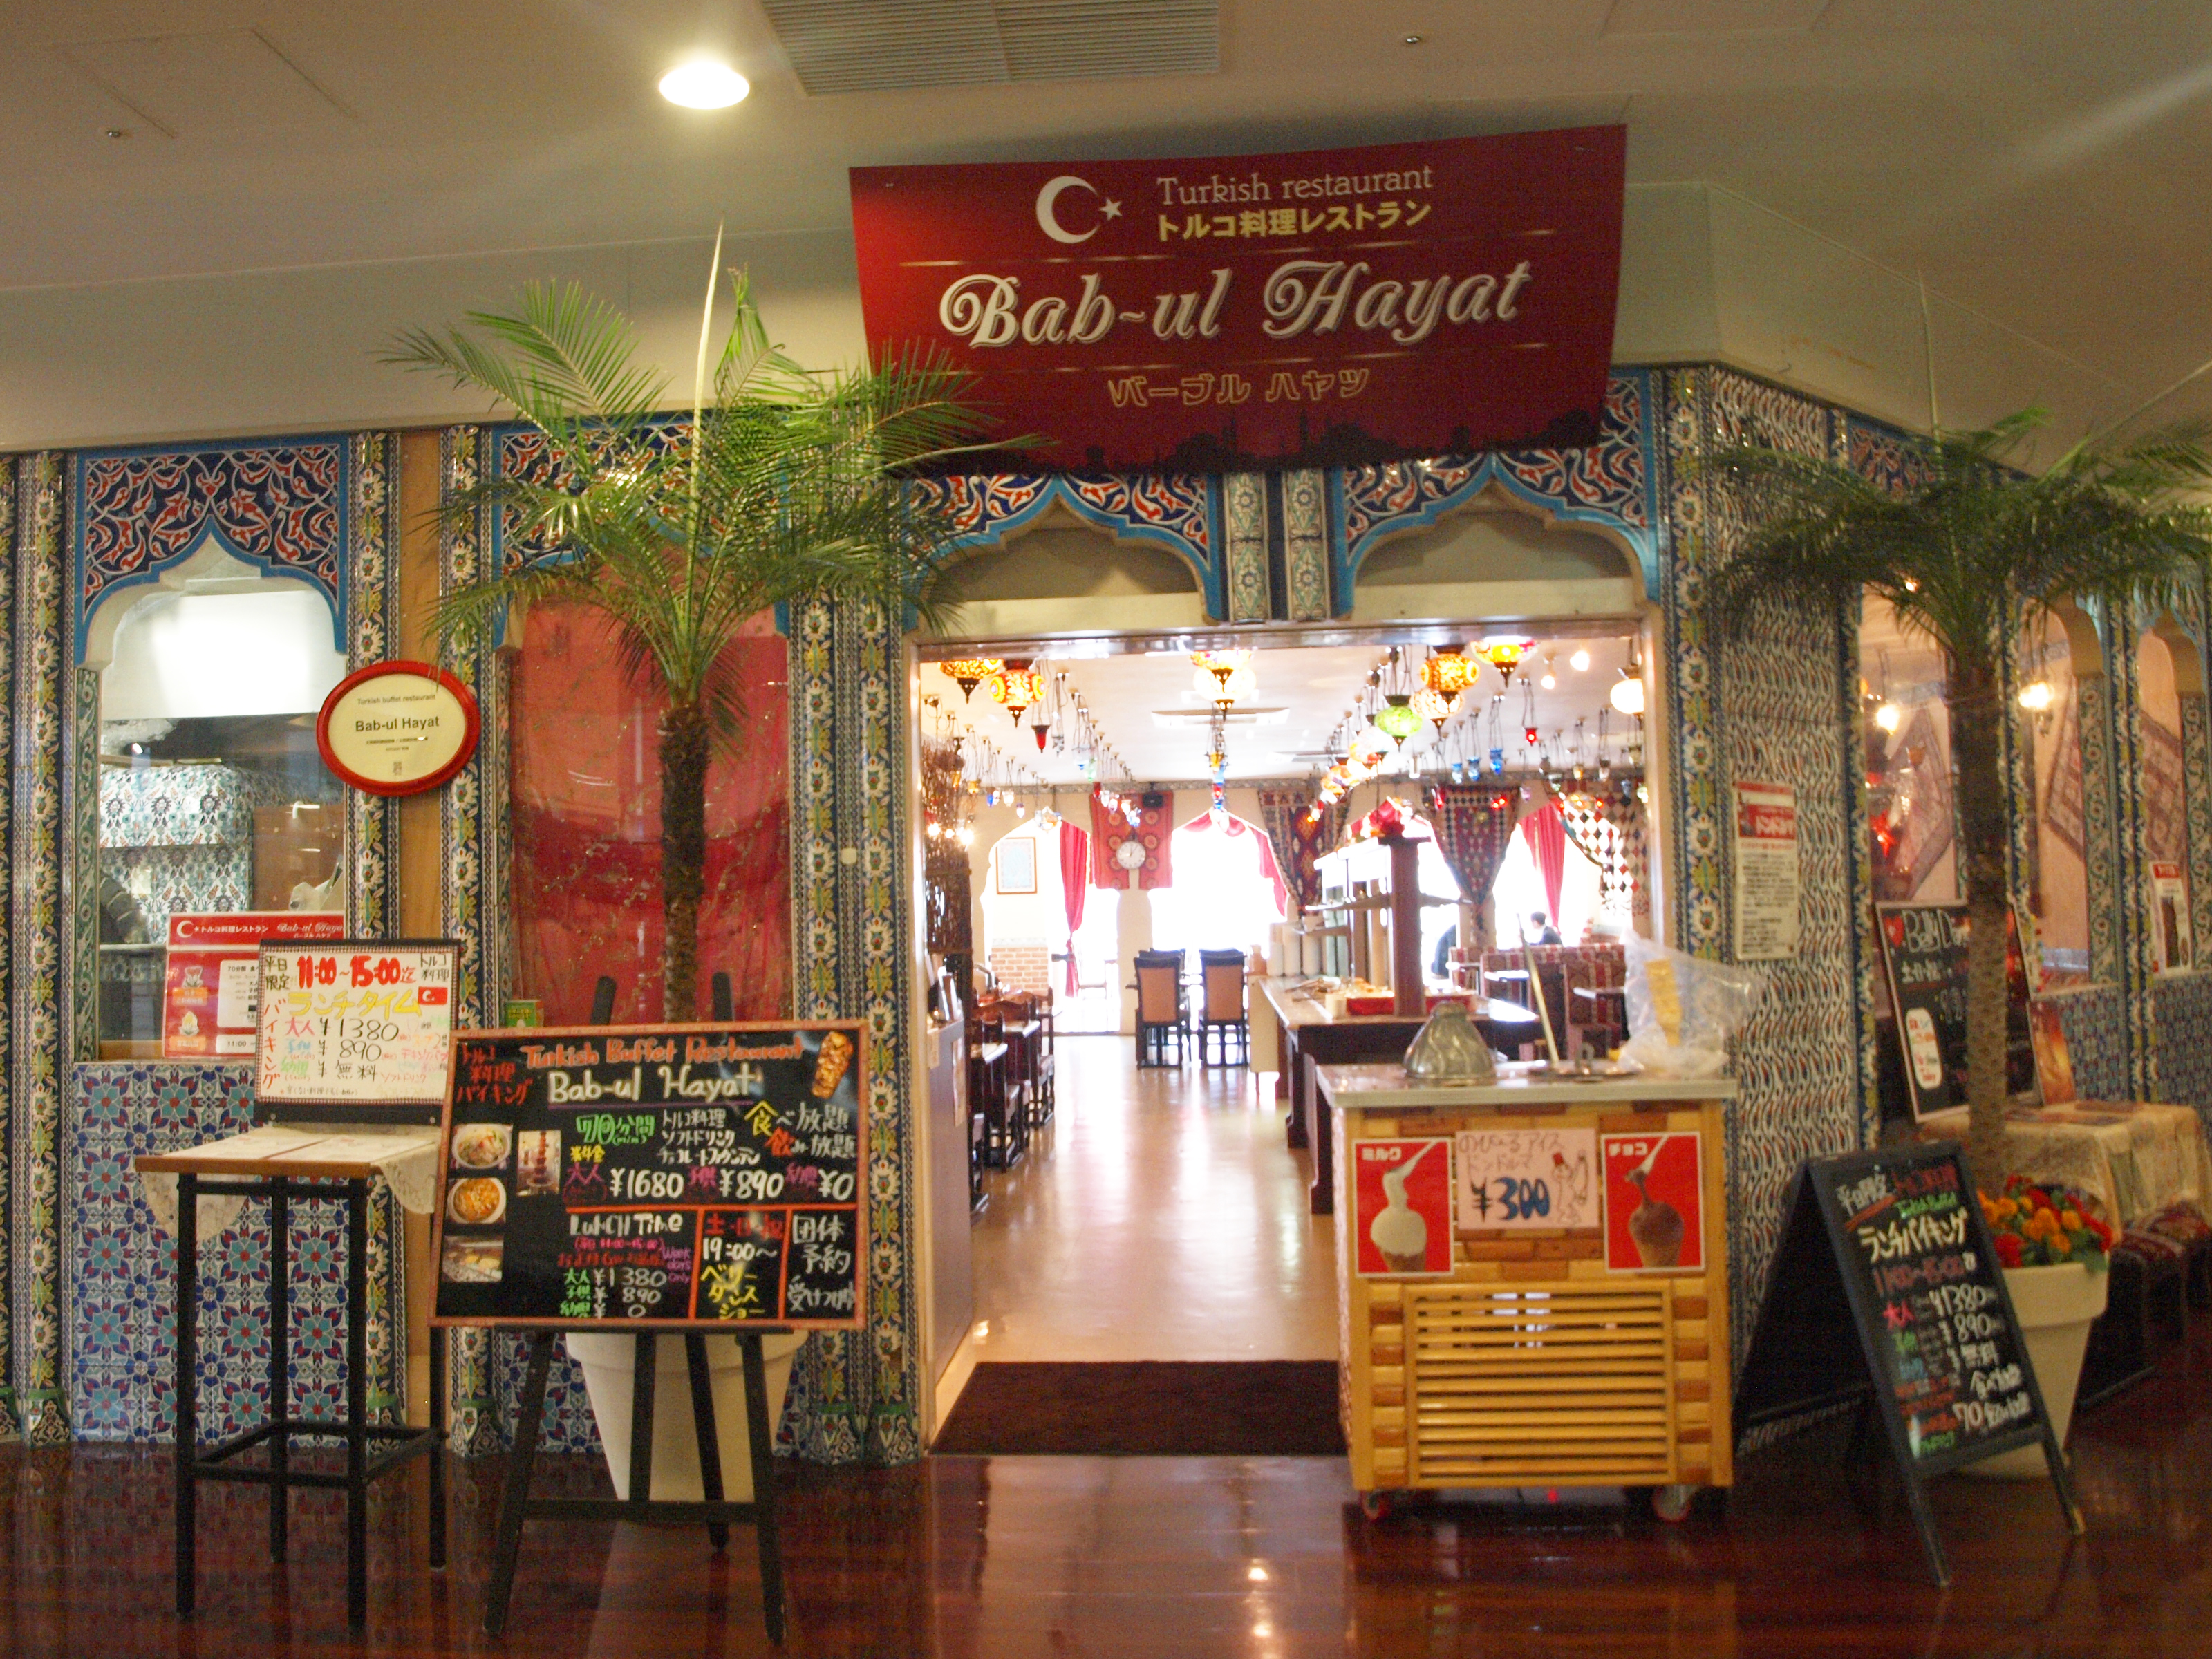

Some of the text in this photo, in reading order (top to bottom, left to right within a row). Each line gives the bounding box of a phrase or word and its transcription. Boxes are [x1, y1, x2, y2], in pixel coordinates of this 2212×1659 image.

[1156, 165, 1434, 205] Turkish restaurant
[1158, 200, 1432, 242] トルコ料理レストラン
[939, 260, 1532, 348] Bab-ul Hayat
[382, 695, 401, 704] buffet
[403, 693, 436, 702] restaurant
[355, 716, 440, 732] Bab-ul Hayat
[200, 924, 269, 934] トルコ料理レストラン
[277, 922, 312, 933] Bab-ul
[266, 955, 288, 973] 平日
[420, 953, 447, 966] トルコ
[266, 974, 290, 991] 限定
[421, 969, 449, 982] 料理
[288, 988, 422, 1021] ランチタイム
[285, 1017, 315, 1037] 大人
[520, 1037, 806, 1069] Turkish Buffet Restaurant
[456, 1078, 534, 1106] バイキング
[548, 1062, 756, 1104] Bab-ul Hayat
[662, 1108, 727, 1130] トルコ料理
[661, 1130, 736, 1148] ソフトドリンク
[1608, 1141, 1649, 1156] チョコ
[609, 1168, 684, 1200] ¥1680
[719, 1168, 785, 1201] ¥890
[818, 1168, 856, 1201] ¥0
[1470, 1177, 1551, 1223] ¥300
[792, 1214, 845, 1244] 団体
[801, 1244, 852, 1274] 予約
[700, 1263, 758, 1290] ベリー
